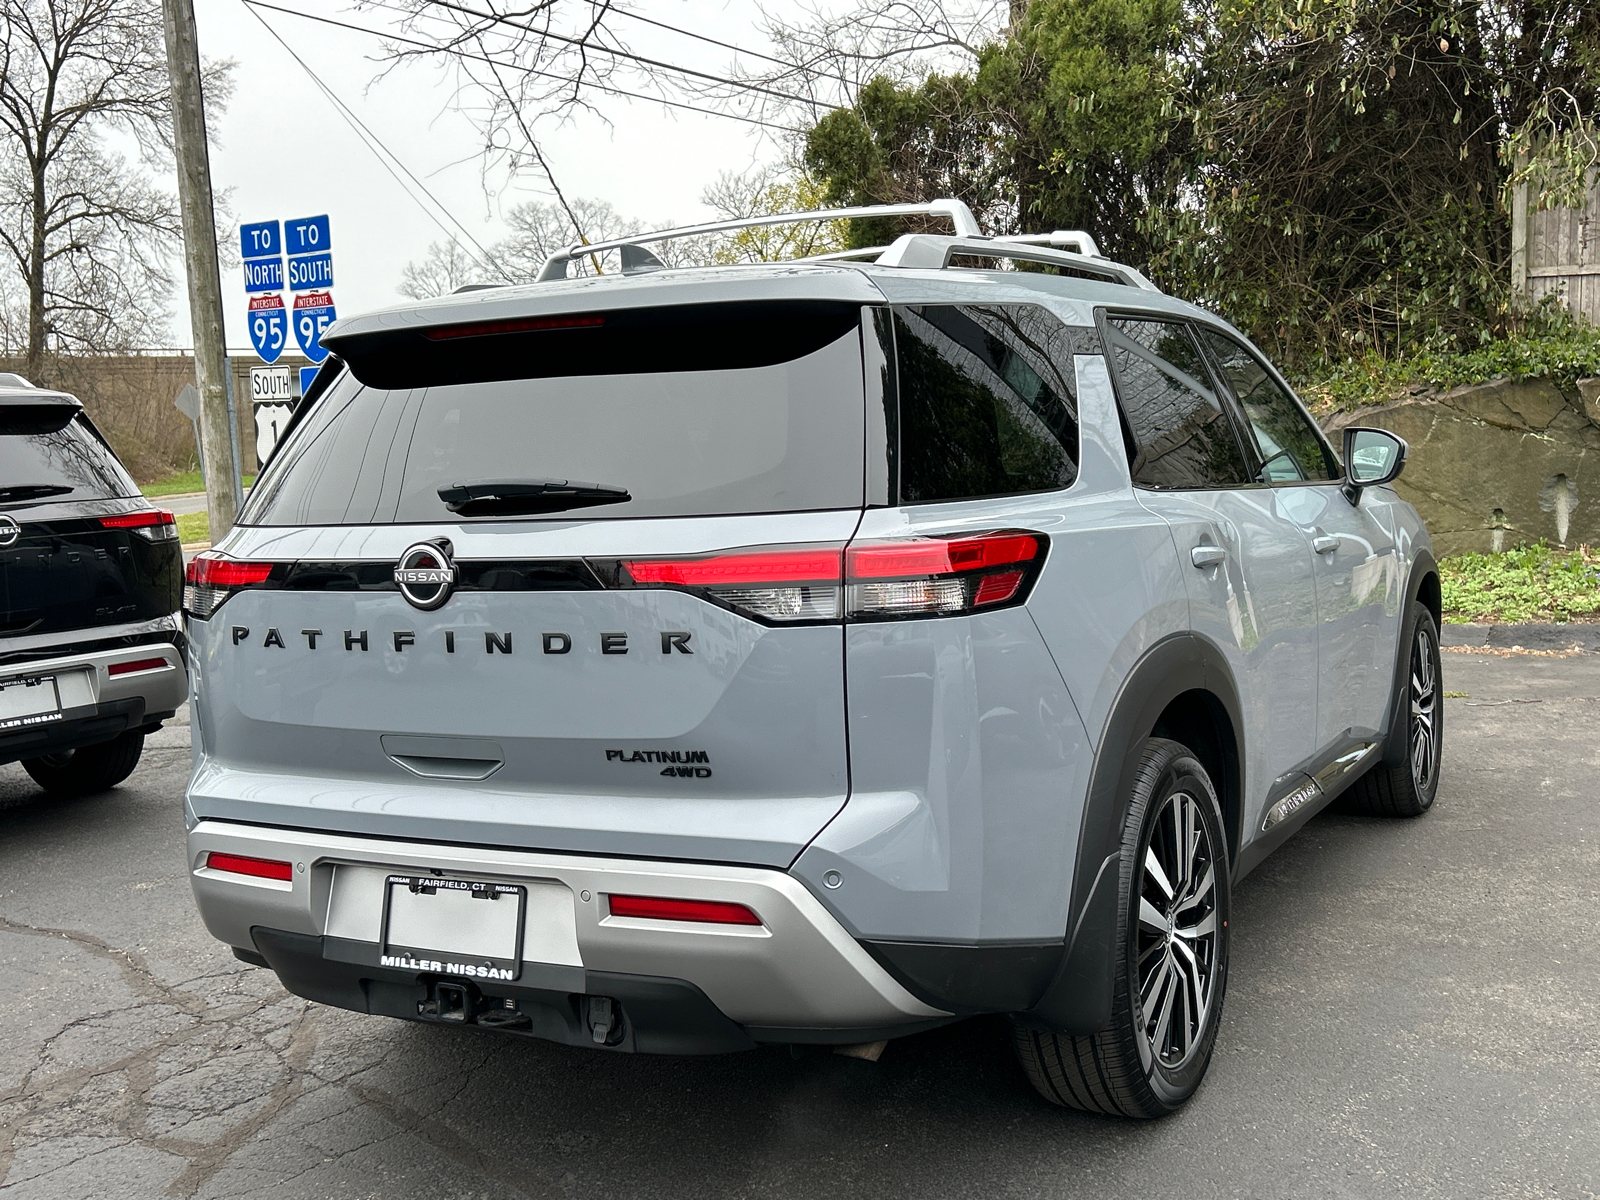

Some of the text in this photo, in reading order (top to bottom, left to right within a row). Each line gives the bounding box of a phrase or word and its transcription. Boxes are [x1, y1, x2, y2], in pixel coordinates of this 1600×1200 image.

[251, 229, 271, 250] TO
[296, 224, 319, 246] TO
[244, 263, 283, 286] NORTH
[290, 259, 332, 284] SOUTH
[251, 298, 280, 309] INTERSTATE
[297, 295, 329, 307] INTERSTATE
[255, 310, 279, 318] CONNECTICUT
[301, 308, 327, 316] CONNECTICUT
[254, 317, 283, 350] 95
[300, 315, 329, 349] 95
[254, 373, 290, 395] SOUTH
[271, 420, 278, 445] 1
[394, 572, 451, 582] NISSAN
[231, 624, 695, 655] PATHFINDER
[0, 713, 63, 728] LER NISSAN
[605, 749, 710, 764] PLATINUM
[660, 765, 712, 778] 4WD
[389, 876, 410, 884] NISSAN
[418, 878, 486, 891] FAIRFIELD, CT
[495, 885, 518, 893] NISSAN
[381, 955, 513, 981] MILLER NISSAN
